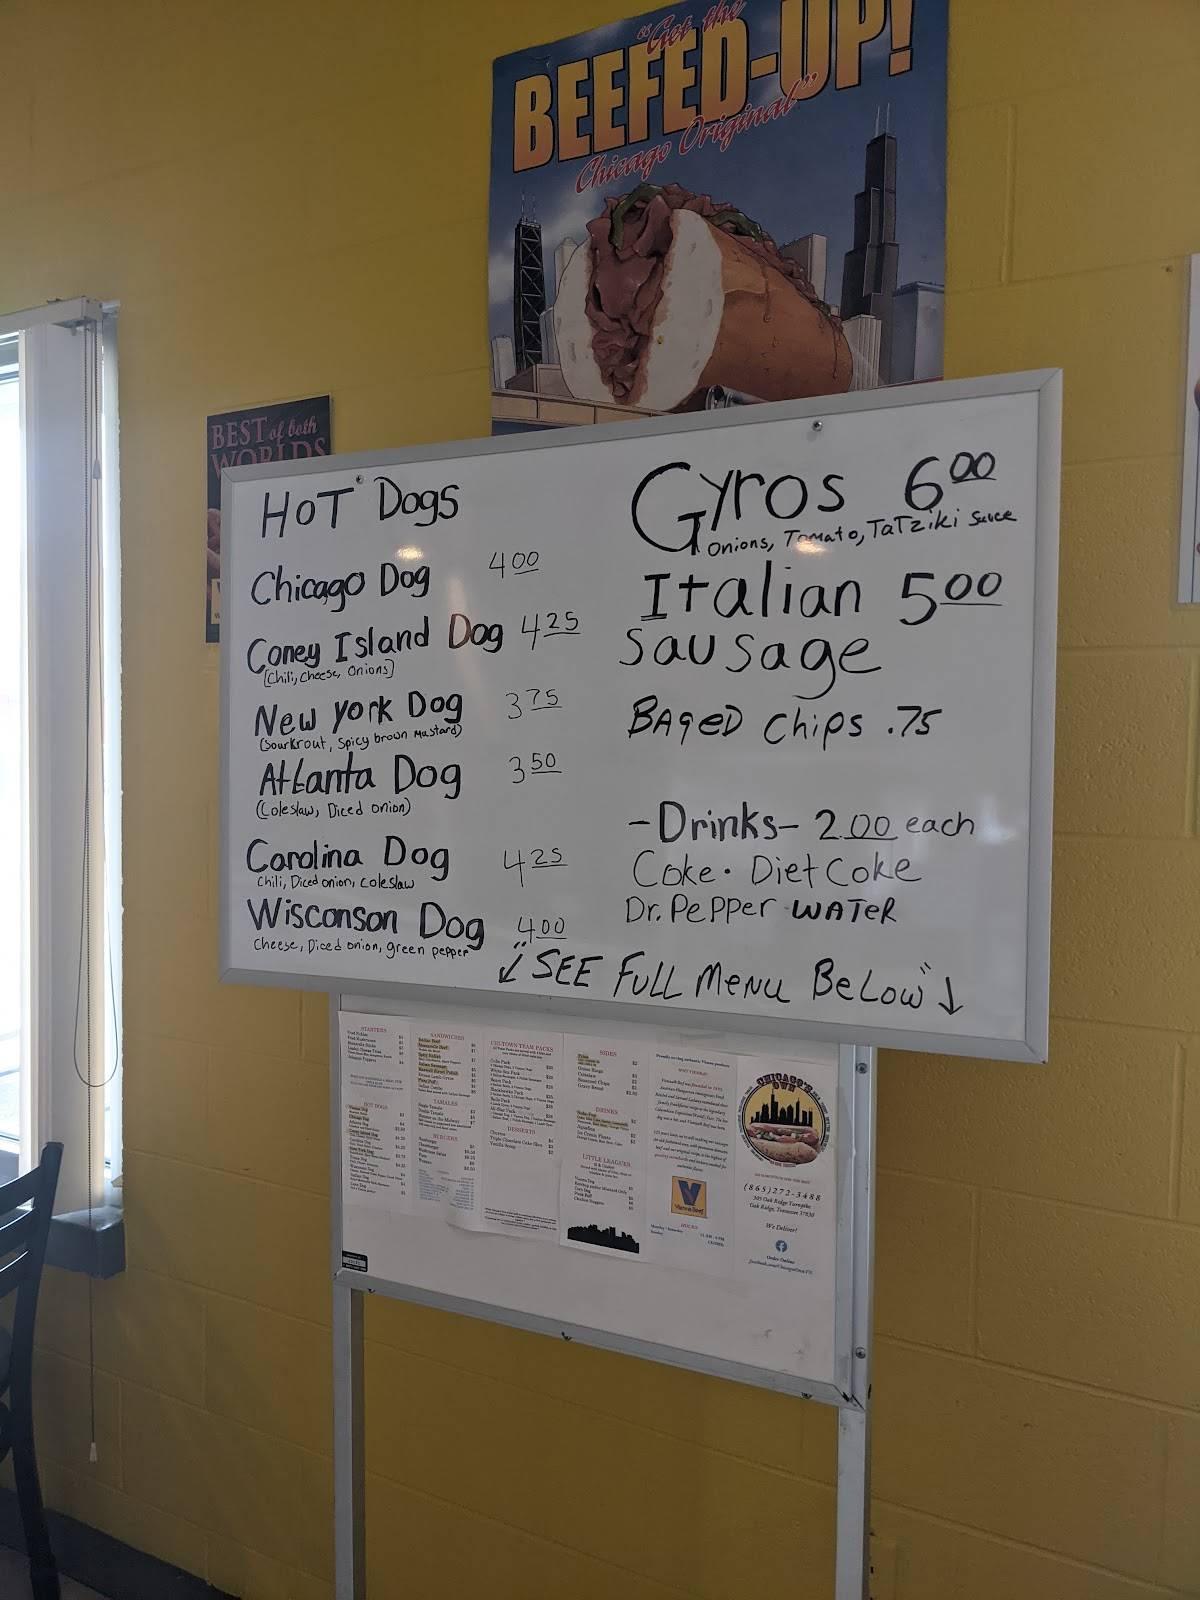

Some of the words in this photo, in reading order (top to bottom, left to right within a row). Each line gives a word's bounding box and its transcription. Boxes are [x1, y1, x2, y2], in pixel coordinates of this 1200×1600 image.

[702, 0, 747, 34] the
[513, 0, 914, 173] BEEFED-UP!
[575, 139, 672, 194] Chicago
[211, 416, 268, 450] BEST
[268, 419, 285, 448] of
[288, 415, 317, 437] both
[631, 461, 845, 555] Gyros
[251, 565, 365, 612] Chicago
[380, 562, 430, 597] Dog
[640, 560, 861, 621] Italian
[247, 638, 321, 674] Coney
[335, 616, 429, 663] Island
[449, 613, 503, 653] Dog
[254, 704, 315, 737] New
[408, 691, 463, 724] Dog
[374, 729, 408, 745] brown
[259, 751, 376, 796] Atlanta
[394, 754, 462, 800] Dog
[328, 801, 363, 818] Diced
[905, 811, 976, 837] each
[247, 838, 364, 873] Carolina
[383, 835, 449, 881] Dog
[632, 850, 717, 888] Coke
[751, 852, 819, 888] Diet
[826, 850, 922, 887] Coke
[290, 875, 320, 889] Diced
[419, 901, 485, 951] Dog
[625, 896, 661, 924] Dr.
[671, 893, 777, 924] Pepper
[308, 938, 342, 955] Diced
[386, 941, 425, 959] green
[432, 945, 469, 960] pepper
[773, 1081, 797, 1093] OWN
[582, 1153, 602, 1163] LITTLE
